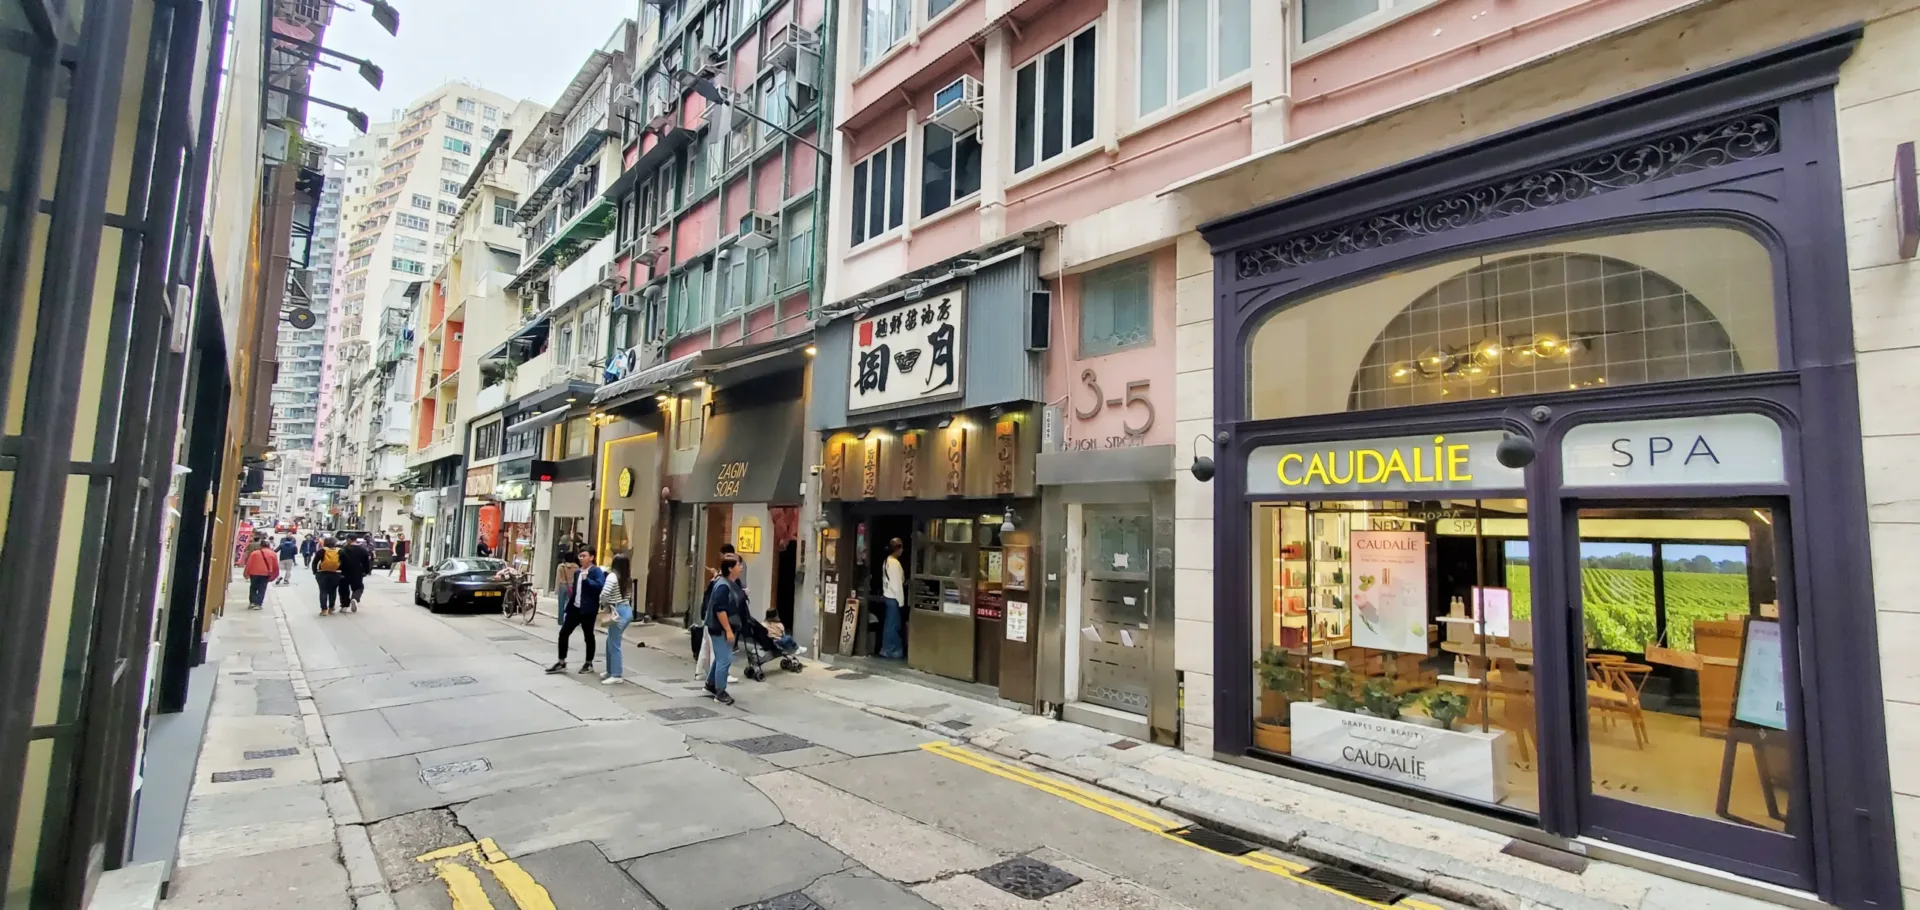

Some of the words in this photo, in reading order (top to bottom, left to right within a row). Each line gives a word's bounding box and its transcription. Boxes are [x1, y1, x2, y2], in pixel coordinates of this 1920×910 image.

[1075, 368, 1156, 436] 3-5
[1611, 435, 1720, 468] SPA
[717, 461, 749, 480] ZAGIN
[713, 480, 740, 497] SOBA
[1341, 719, 1372, 730] GRAPES
